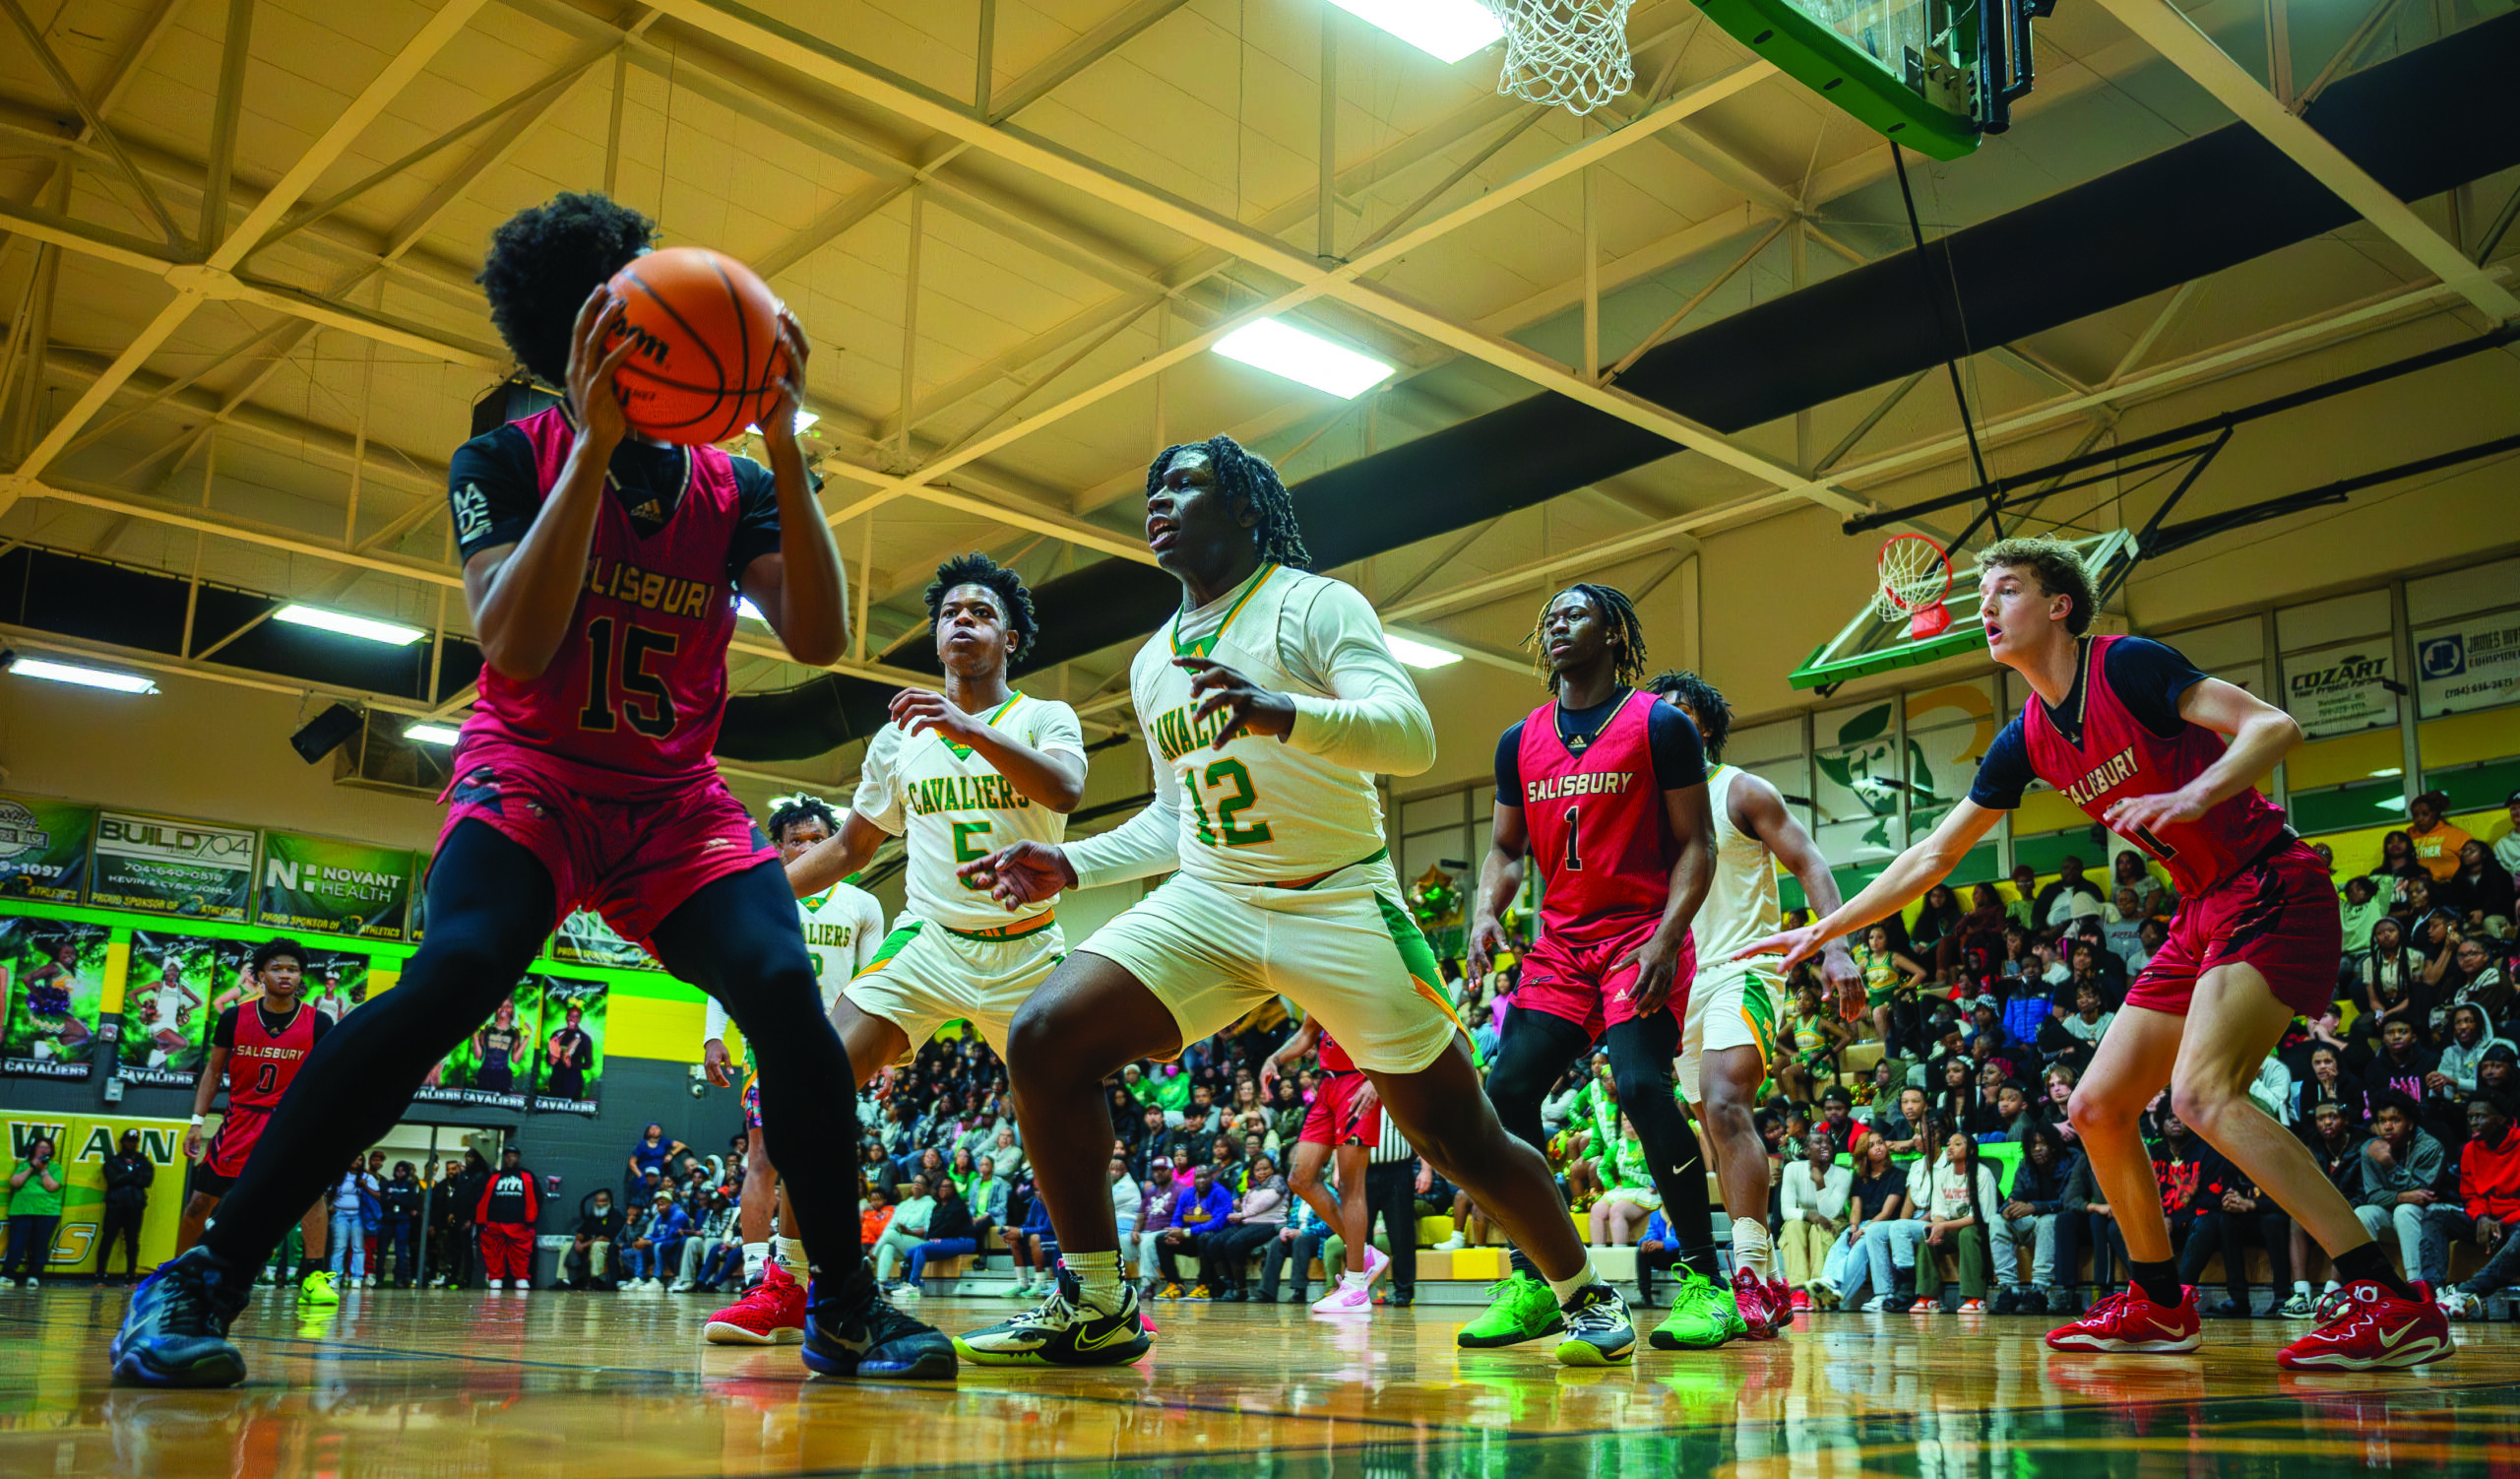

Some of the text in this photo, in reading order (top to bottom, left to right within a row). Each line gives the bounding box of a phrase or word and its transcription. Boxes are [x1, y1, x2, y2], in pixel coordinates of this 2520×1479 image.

[585, 557, 714, 619] LISBUR
[578, 616, 678, 739] 15
[2292, 657, 2387, 690] COZART
[1150, 696, 1253, 763] AVALIE
[1527, 772, 1636, 804] SALISBURY
[2059, 744, 2139, 807] ALIBURY
[1185, 756, 1274, 848] 12
[1564, 804, 1582, 871] 1
[952, 820, 996, 891] 5
[108, 874, 145, 885] KEVIN
[197, 884, 232, 896] JONES
[267, 858, 298, 890] N
[323, 867, 402, 889] NOVANT
[91, 892, 122, 906] PROUD
[123, 895, 165, 909] SPONSOR
[166, 899, 179, 911] OF
[321, 881, 391, 902] HEALTH
[261, 911, 288, 925] PROUD
[290, 915, 329, 930] SPONSOR
[330, 920, 341, 932] OF
[360, 924, 401, 937] ATHLETICS
[800, 923, 851, 947] LIERS
[236, 1045, 304, 1061] SALISBURY
[4, 1060, 89, 1076] CAVALIERS
[117, 1069, 194, 1084] CAVALIERS
[255, 1062, 278, 1094] 0
[414, 1089, 461, 1102] ALIERS
[464, 1093, 525, 1108] CAVALIERS
[536, 1099, 596, 1112] CAVALIERS
